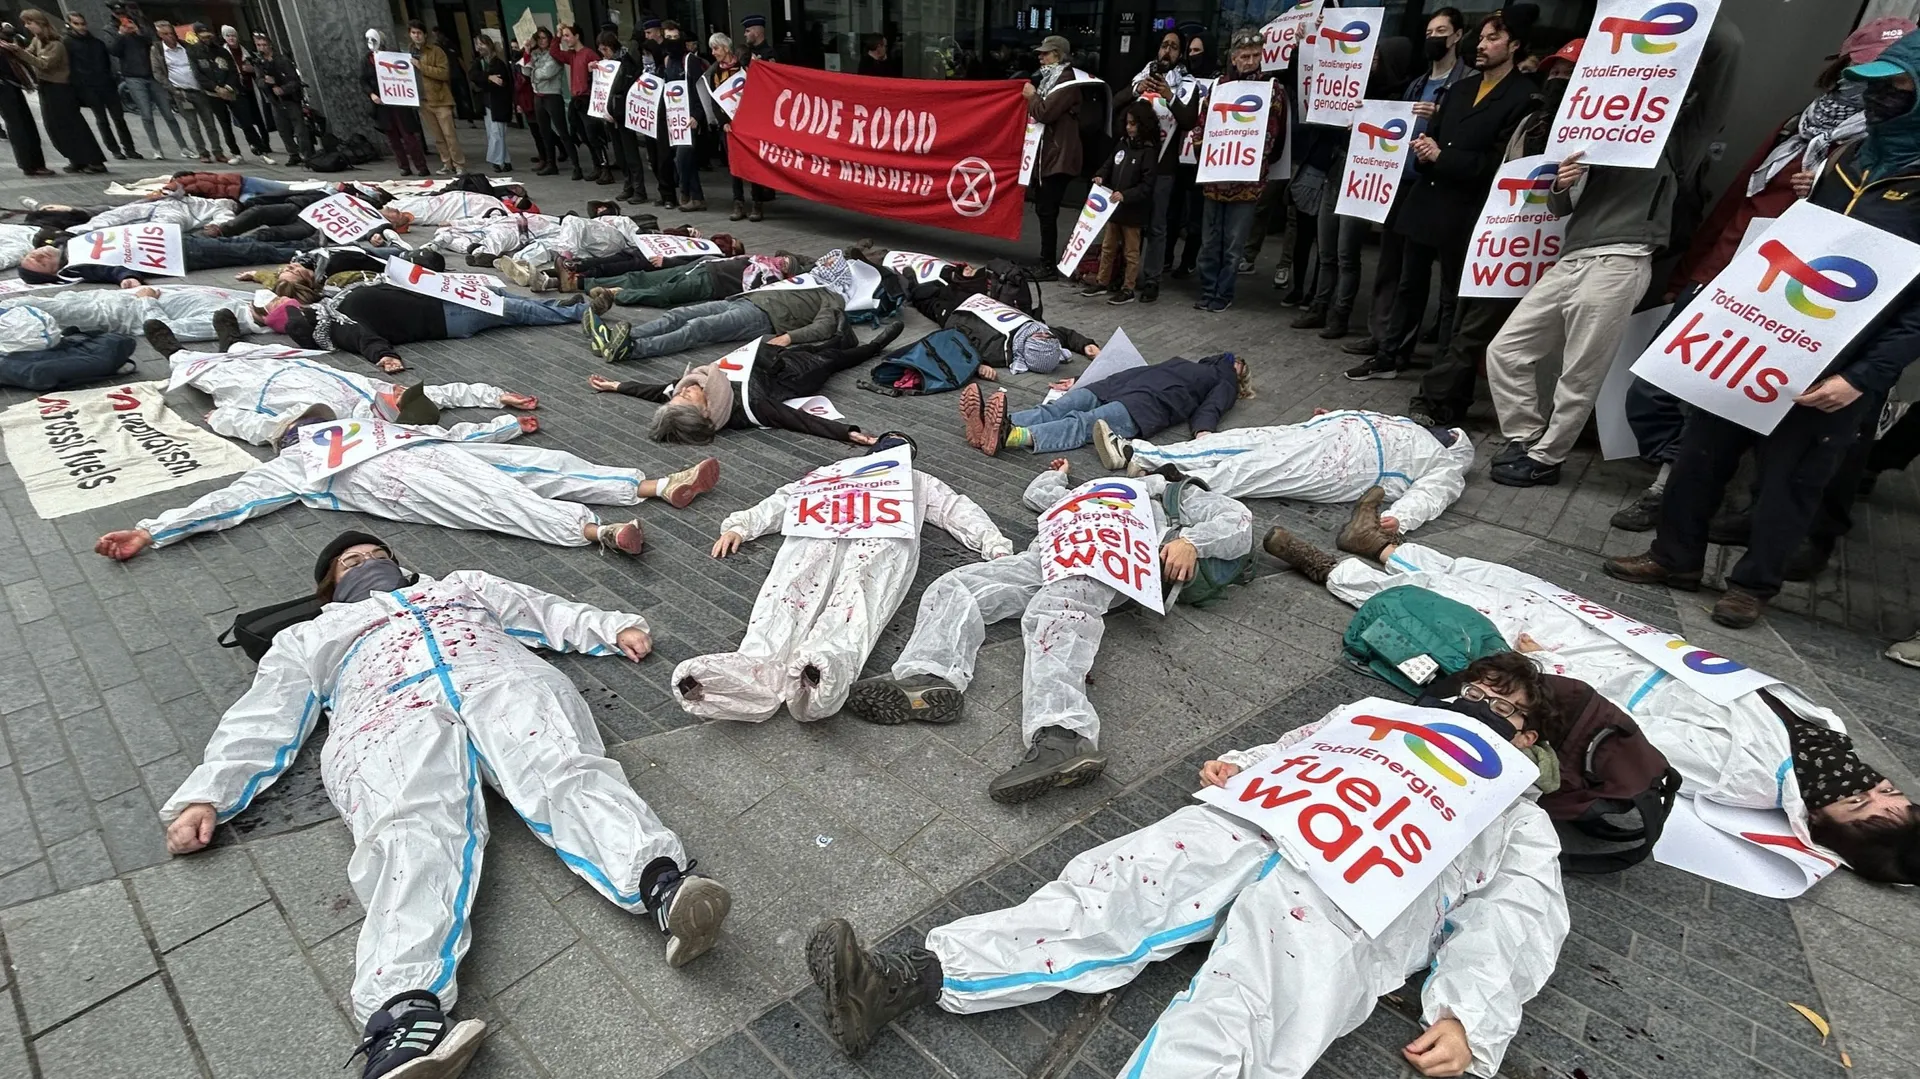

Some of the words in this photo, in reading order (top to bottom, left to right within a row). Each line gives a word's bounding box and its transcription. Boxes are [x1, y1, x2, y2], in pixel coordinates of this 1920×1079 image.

[1265, 26, 1295, 44] fue
[1262, 43, 1297, 64] wa
[1319, 60, 1363, 71] TotalEnergies
[1316, 73, 1360, 98] fuels
[1581, 65, 1678, 81] TotalEnergies
[383, 83, 415, 98] kills
[1314, 98, 1355, 111] genocide
[1566, 86, 1670, 123] fuels
[628, 100, 655, 120] fuels
[628, 113, 655, 131] war
[773, 89, 844, 140] CODE
[849, 104, 937, 154] ROOD
[1208, 128, 1259, 138] TotalEnergies
[1556, 124, 1656, 144] genocide
[758, 139, 805, 171] VOOR
[810, 155, 831, 177] DE
[839, 159, 934, 197] MENSHEID
[1205, 141, 1257, 167] kills
[1352, 155, 1399, 170] TotalEnergies
[1346, 170, 1393, 205] kills
[311, 208, 354, 239] war
[320, 202, 363, 234] fuels
[136, 226, 168, 269] kills
[1476, 228, 1561, 258] fuels
[1710, 288, 1823, 354] TotalEnergies
[1664, 312, 1789, 404] kills
[59, 448, 123, 490] fuels
[798, 491, 902, 525] kills
[1053, 527, 1151, 564] fuels
[1053, 544, 1152, 591] war
[1311, 741, 1457, 822] TotalEnergies
[1271, 755, 1432, 864] fuels
[1238, 776, 1404, 884] war
